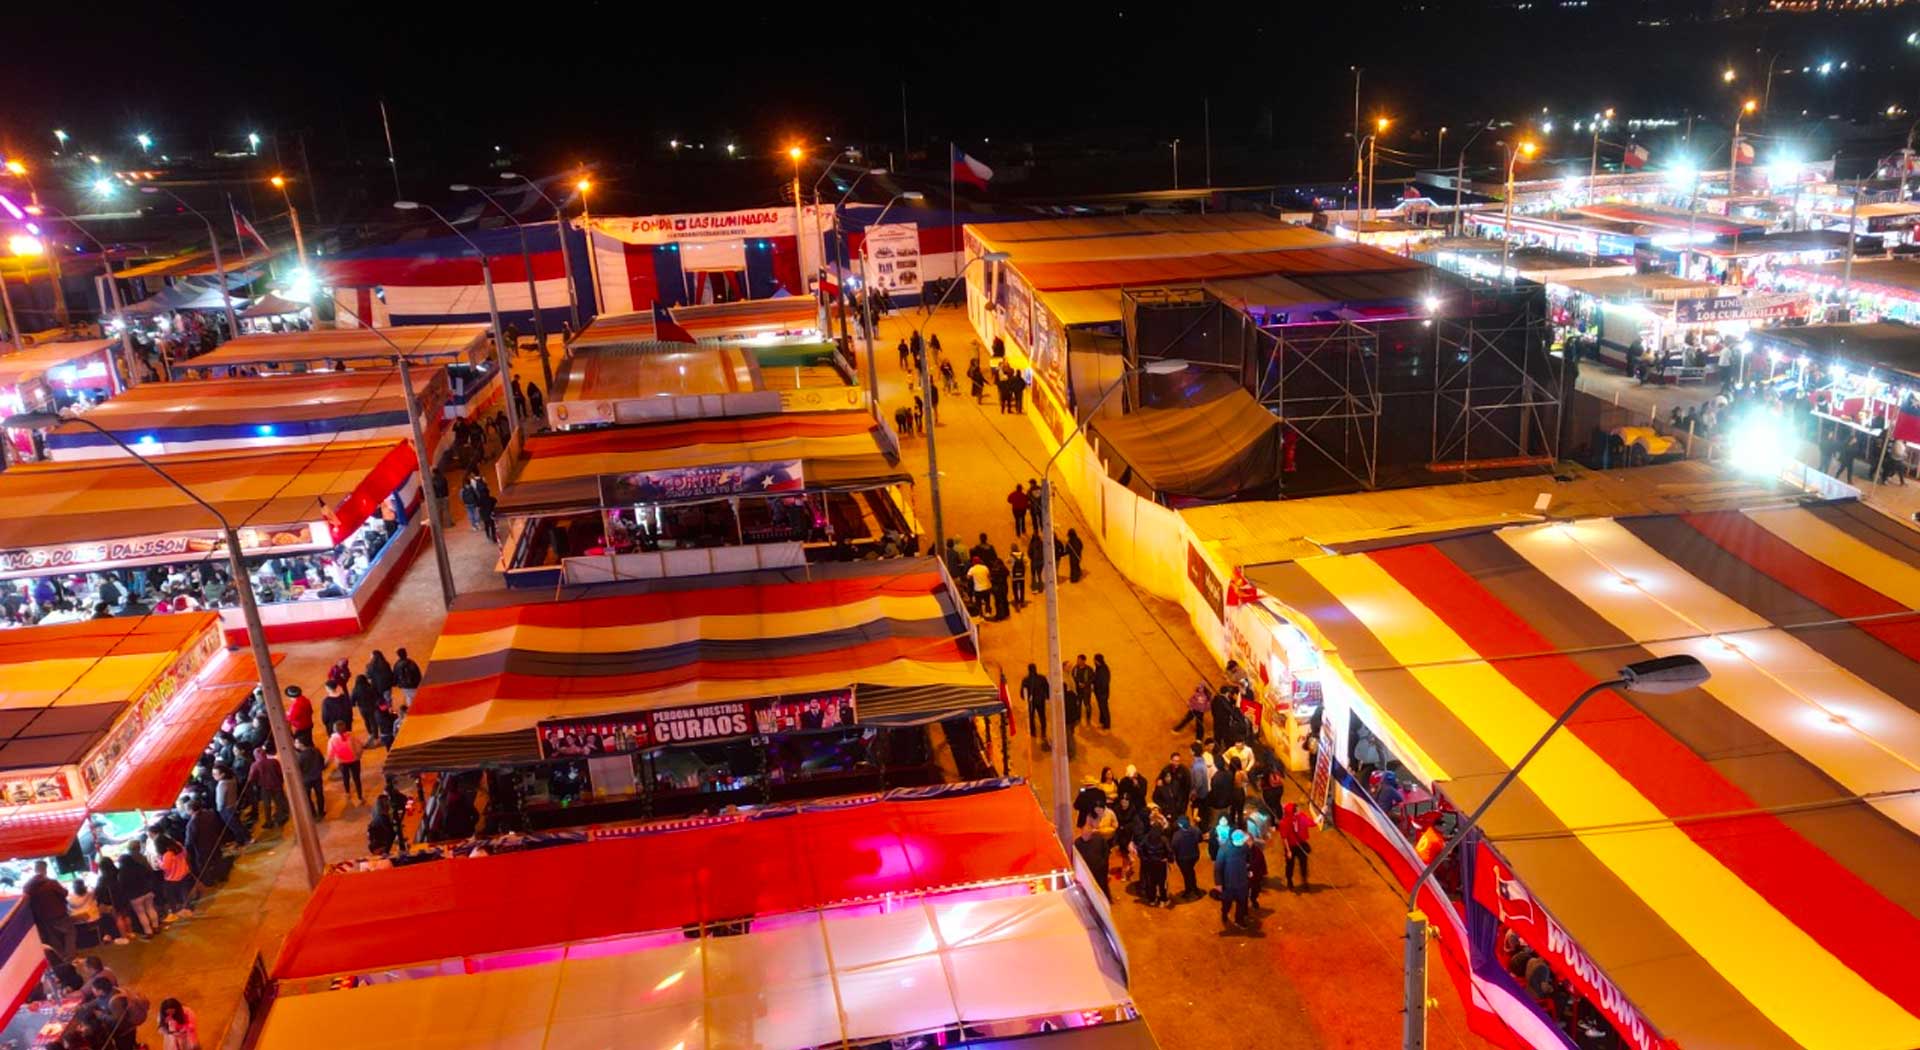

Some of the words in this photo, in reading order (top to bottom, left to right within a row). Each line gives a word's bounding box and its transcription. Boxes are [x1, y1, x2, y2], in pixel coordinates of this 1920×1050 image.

[631, 218, 673, 233] FONDA
[689, 216, 709, 229] LAS
[711, 212, 778, 228] ILUMINADAS
[1697, 311, 1716, 321] LOS
[112, 538, 187, 557] DALISON
[653, 709, 695, 722] PERDONA
[697, 703, 744, 718] NUESTROS
[654, 713, 748, 742] CURAOS
